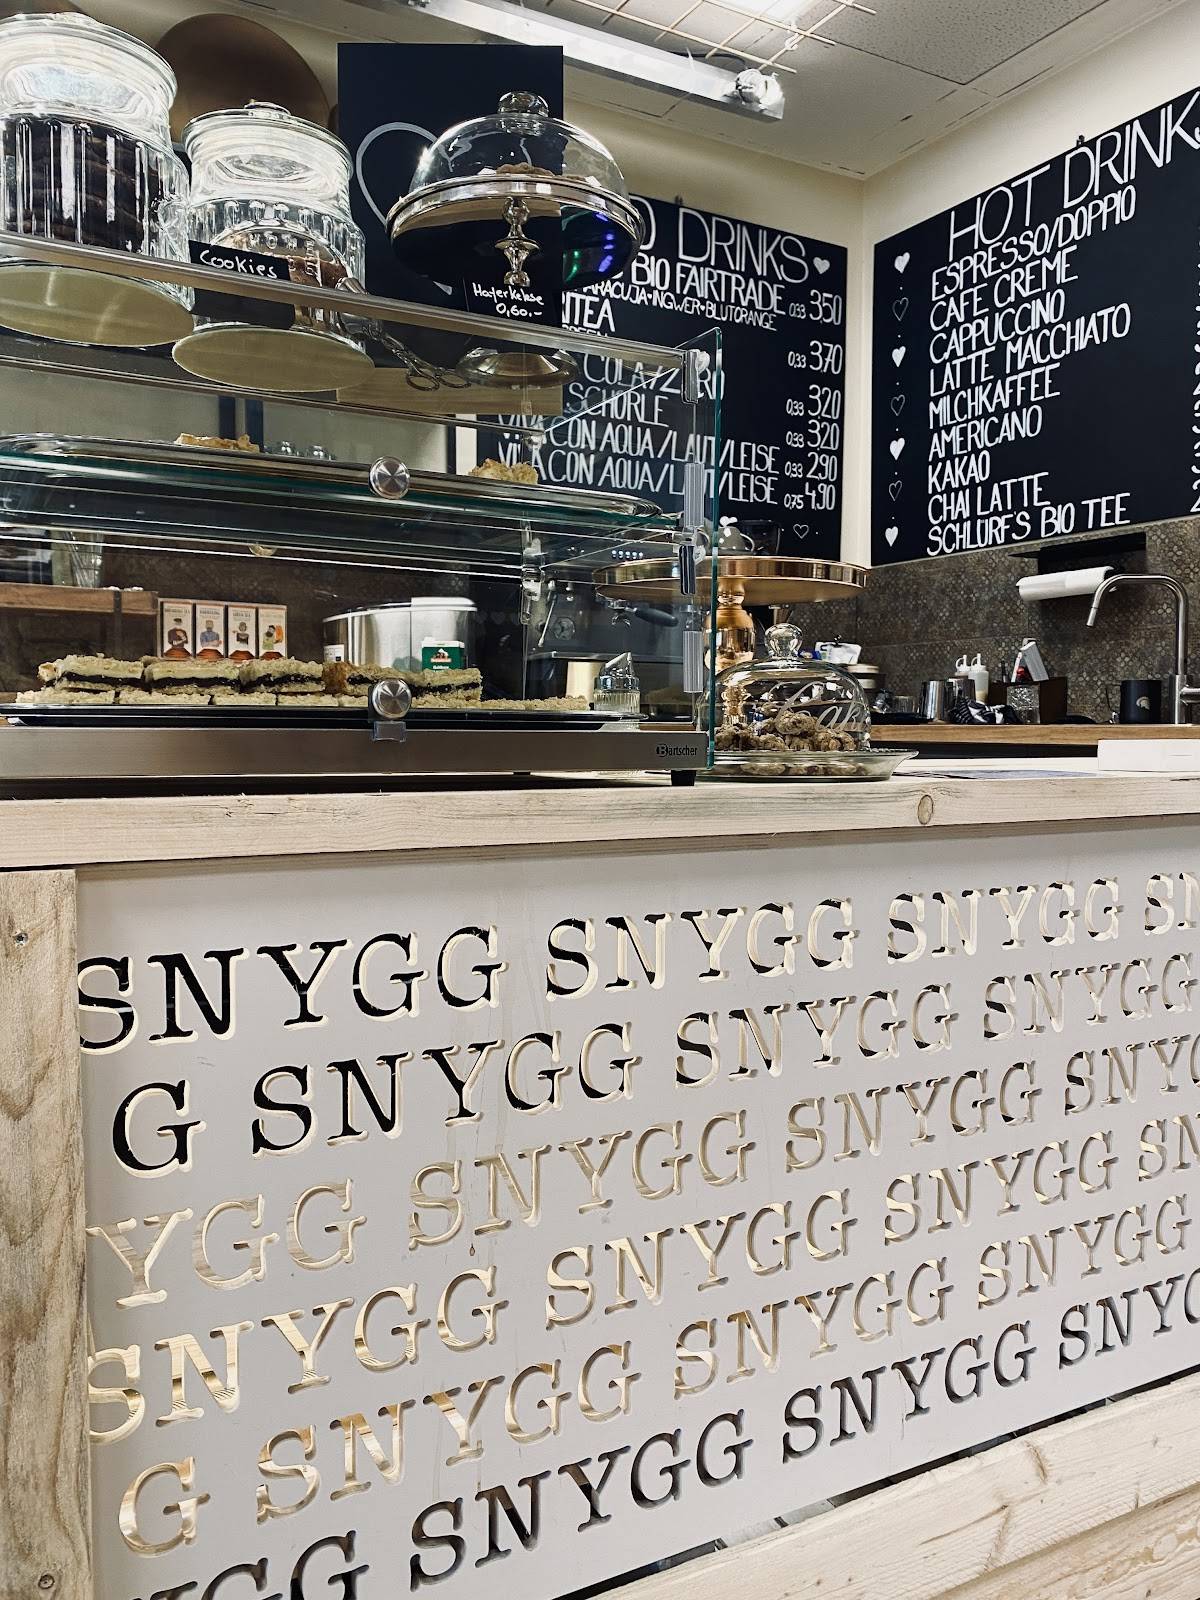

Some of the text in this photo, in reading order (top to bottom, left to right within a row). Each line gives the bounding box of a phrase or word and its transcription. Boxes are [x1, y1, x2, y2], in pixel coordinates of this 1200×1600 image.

[948, 89, 1200, 262] HOT DRINK
[200, 249, 278, 280] Cookies
[677, 206, 809, 284] DRINKS
[931, 184, 1136, 301] ESPRESSO/DOPPIO
[630, 251, 671, 291] BIO
[674, 263, 786, 317] FAIRTRADE
[930, 244, 1079, 332] CAFE CREME
[929, 288, 1066, 365] CAPPUCCINO
[930, 302, 1131, 397] LATTE MACCHIATO
[550, 416, 597, 451] CON
[928, 363, 1060, 429] MILCHKAFFEE
[928, 405, 1043, 462] AMERICANO
[548, 450, 595, 485] CON
[928, 449, 991, 494] KAKAO
[928, 471, 1051, 525] CHAI LATTE
[1040, 502, 1076, 538] BIO
[1081, 492, 1132, 528] TEE
[656, 743, 698, 758] Bartscher
[78, 924, 508, 1055] SNYGG
[545, 897, 861, 1002] SNYGG
[887, 876, 1123, 965] SNYGG
[112, 952, 1200, 1178] G SNYGG SNYGG SNYGG
[87, 1031, 1200, 1309] YGG SNYGG SNYGG SNY
[88, 1264, 509, 1445] SNYGG
[546, 1188, 858, 1331] SNYGG
[884, 1130, 1120, 1246] SNYGG
[118, 1193, 1193, 1558] G SNYGG SNYGG SNYGG
[410, 1408, 754, 1593] SNYGG
[782, 1319, 1037, 1464] SNYGG
